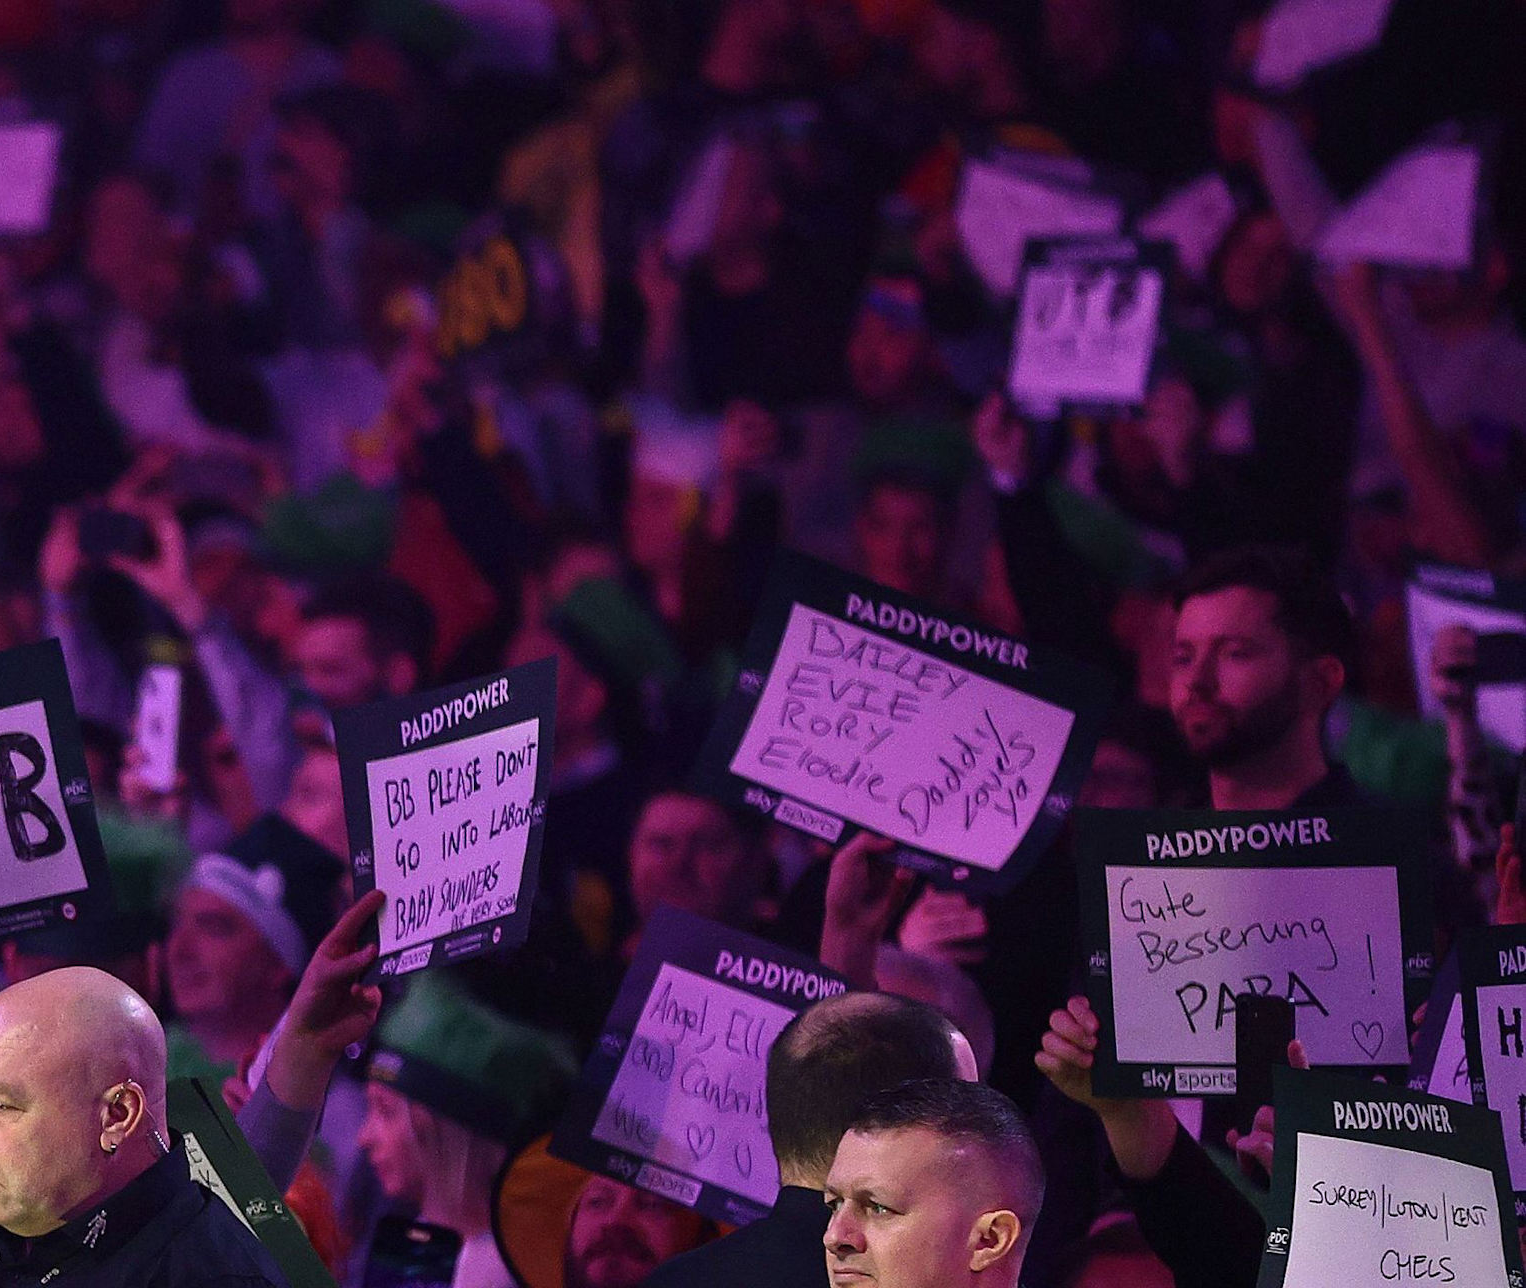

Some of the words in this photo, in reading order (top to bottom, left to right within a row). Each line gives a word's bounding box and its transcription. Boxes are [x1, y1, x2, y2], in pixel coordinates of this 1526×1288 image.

[846, 593, 1029, 670] PADDYPOWER
[400, 677, 509, 747] PADDYPOWER
[786, 662, 921, 724] EVIE
[780, 701, 894, 754] RORY
[384, 778, 415, 829] BB
[428, 757, 482, 815] PLEASE
[758, 736, 887, 802] Elodie
[395, 838, 420, 879] GO
[442, 820, 478, 860] INTO
[1146, 818, 1332, 861] PADDYPOWER
[395, 885, 435, 942] BABY
[438, 861, 501, 917] SAUNDERS
[1120, 877, 1207, 924] Gute
[1136, 917, 1339, 974] Besserung
[1142, 1072, 1172, 1089] sky
[1177, 1071, 1237, 1093] sports
[1333, 1101, 1454, 1134] PADDYPOWER
[1380, 1249, 1456, 1283] CHELS
